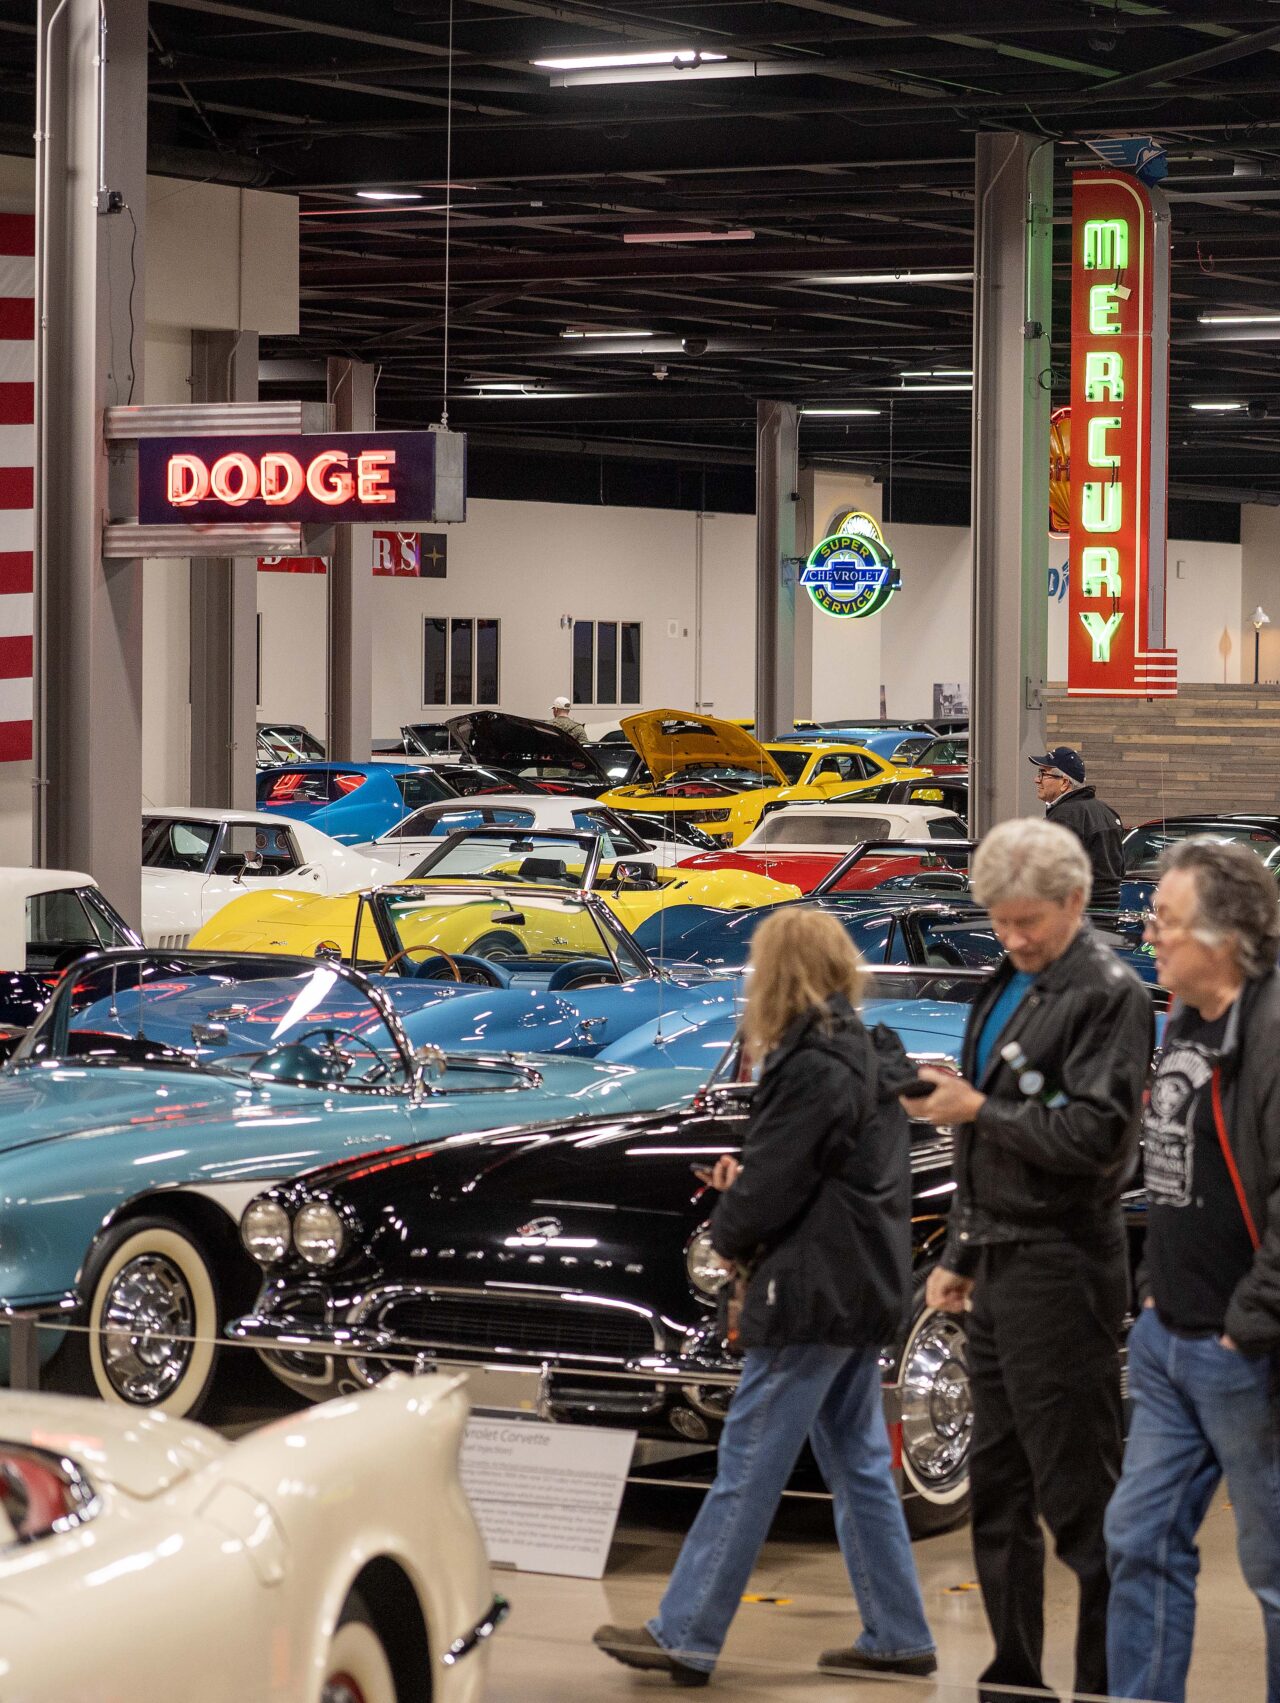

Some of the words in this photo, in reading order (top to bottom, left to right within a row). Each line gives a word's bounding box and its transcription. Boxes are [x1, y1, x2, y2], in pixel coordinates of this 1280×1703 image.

[1079, 219, 1129, 663] MERCURY
[167, 449, 397, 507] DODGE
[821, 538, 869, 558] SUPER
[809, 571, 881, 581] CHEVROLET
[815, 588, 874, 613] SERVICE
